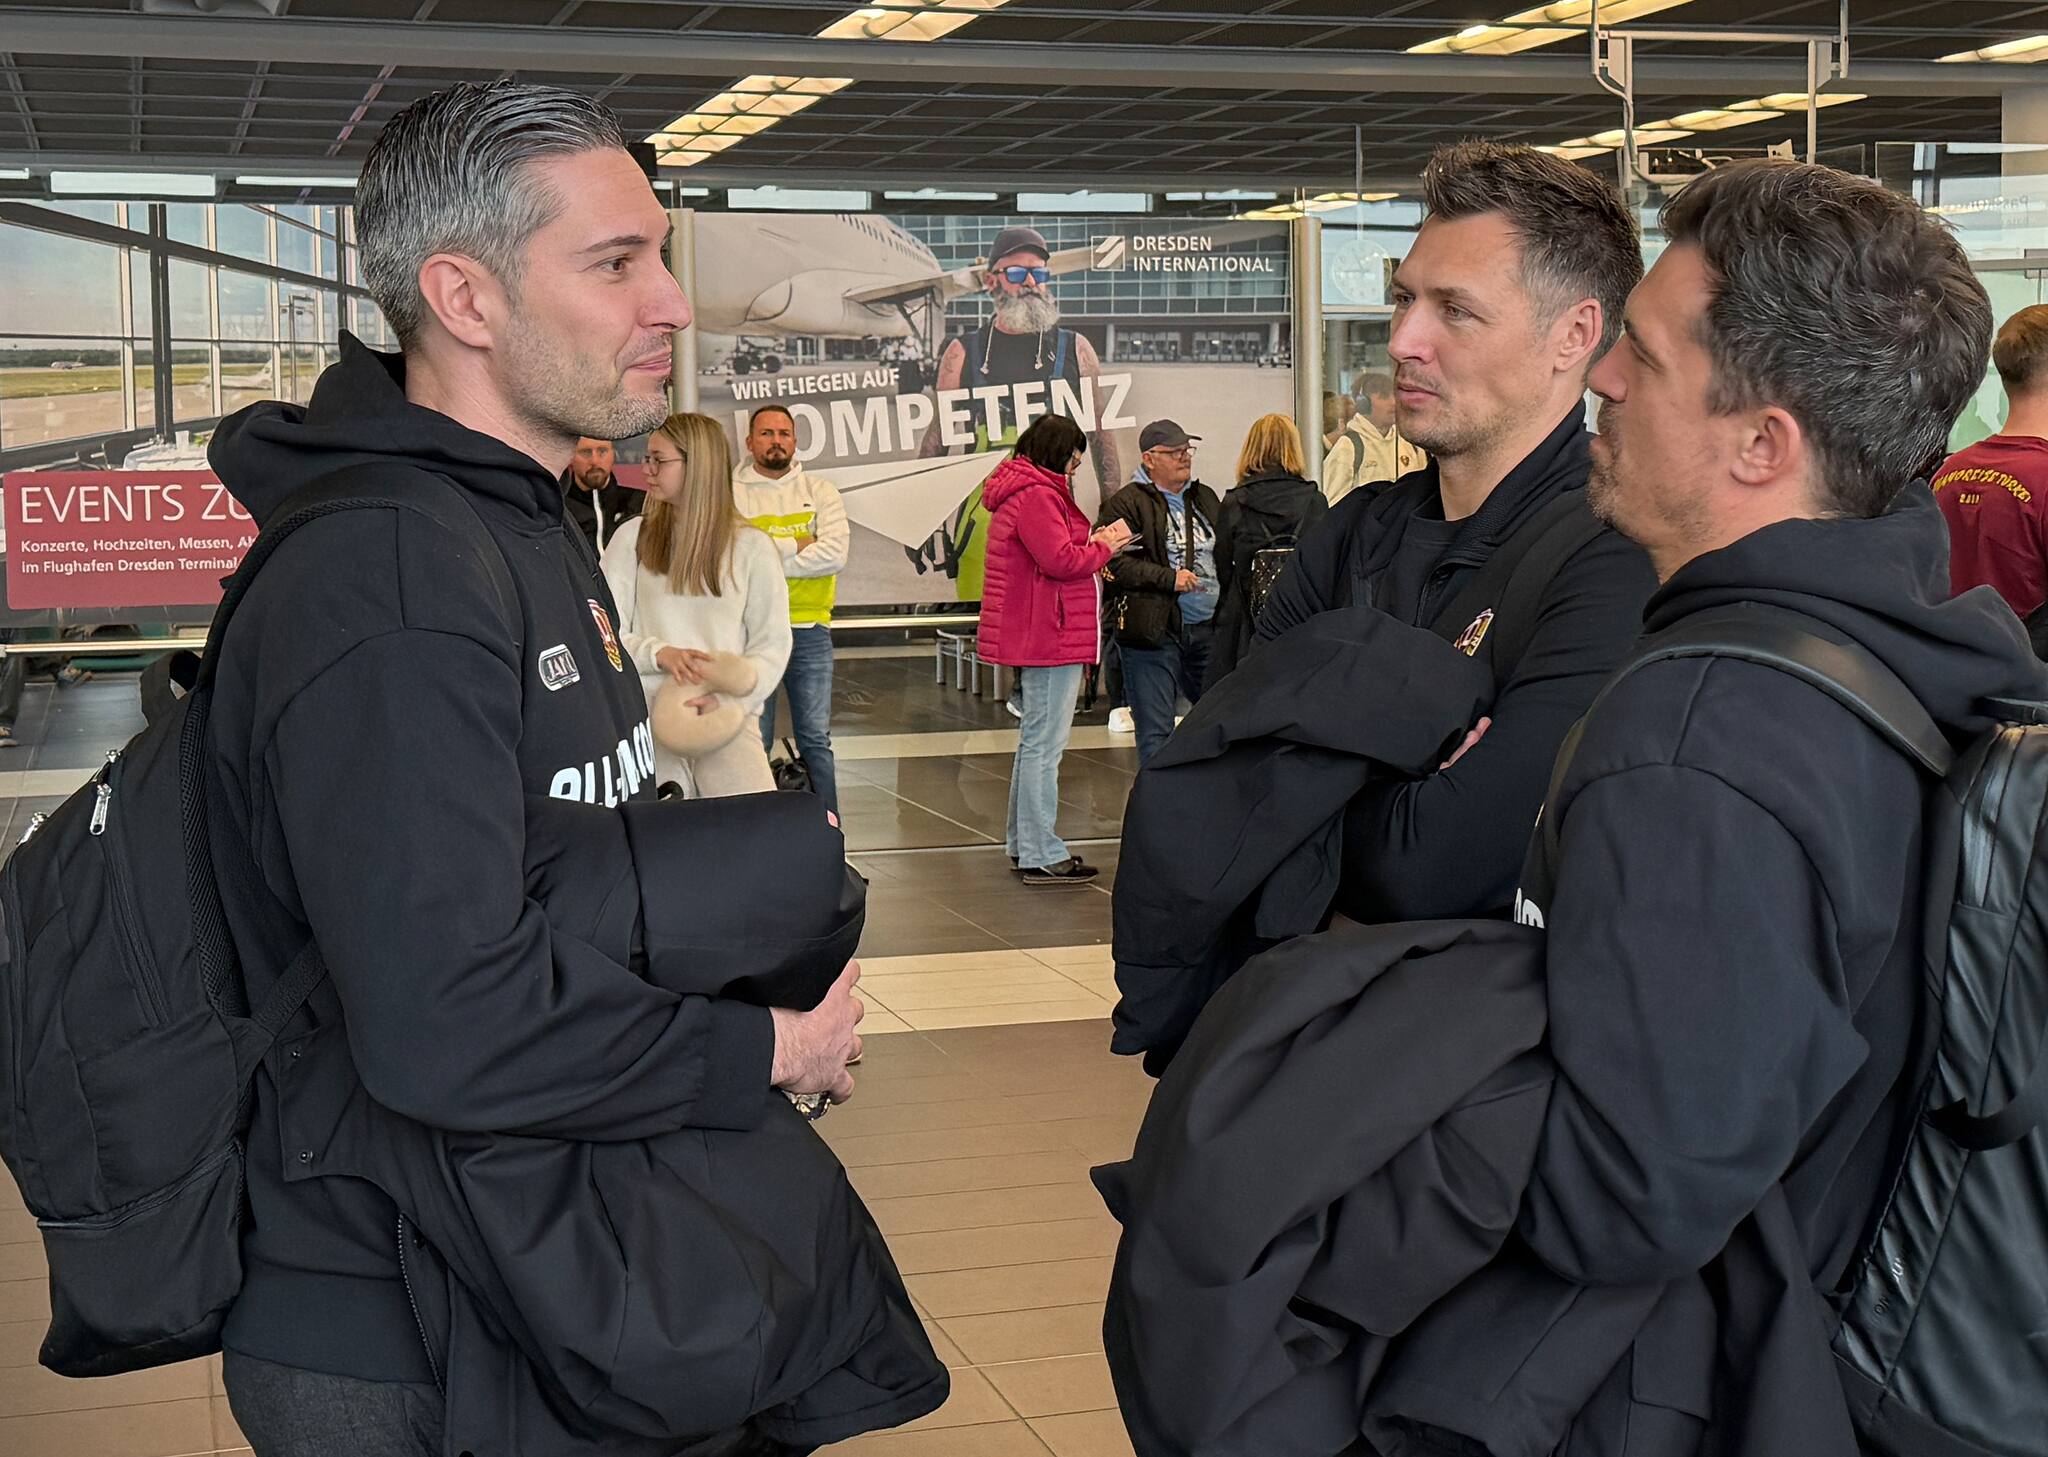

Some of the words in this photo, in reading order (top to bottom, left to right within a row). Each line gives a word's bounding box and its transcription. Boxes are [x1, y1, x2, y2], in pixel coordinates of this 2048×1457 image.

[1133, 236, 1212, 251] DRESDEN
[1133, 257, 1274, 272] INTERNATIONAL
[732, 379, 772, 400] WIR
[777, 372, 856, 397] FLIEGEN
[862, 368, 900, 389] AUF
[21, 485, 185, 523] EVENTS
[21, 540, 89, 553] Konzerte,
[93, 538, 176, 551] Hochzeiten,
[179, 537, 234, 550] Messen,
[44, 559, 114, 575] Flughafen
[118, 558, 175, 571] Dresden
[177, 556, 238, 570] Terminal
